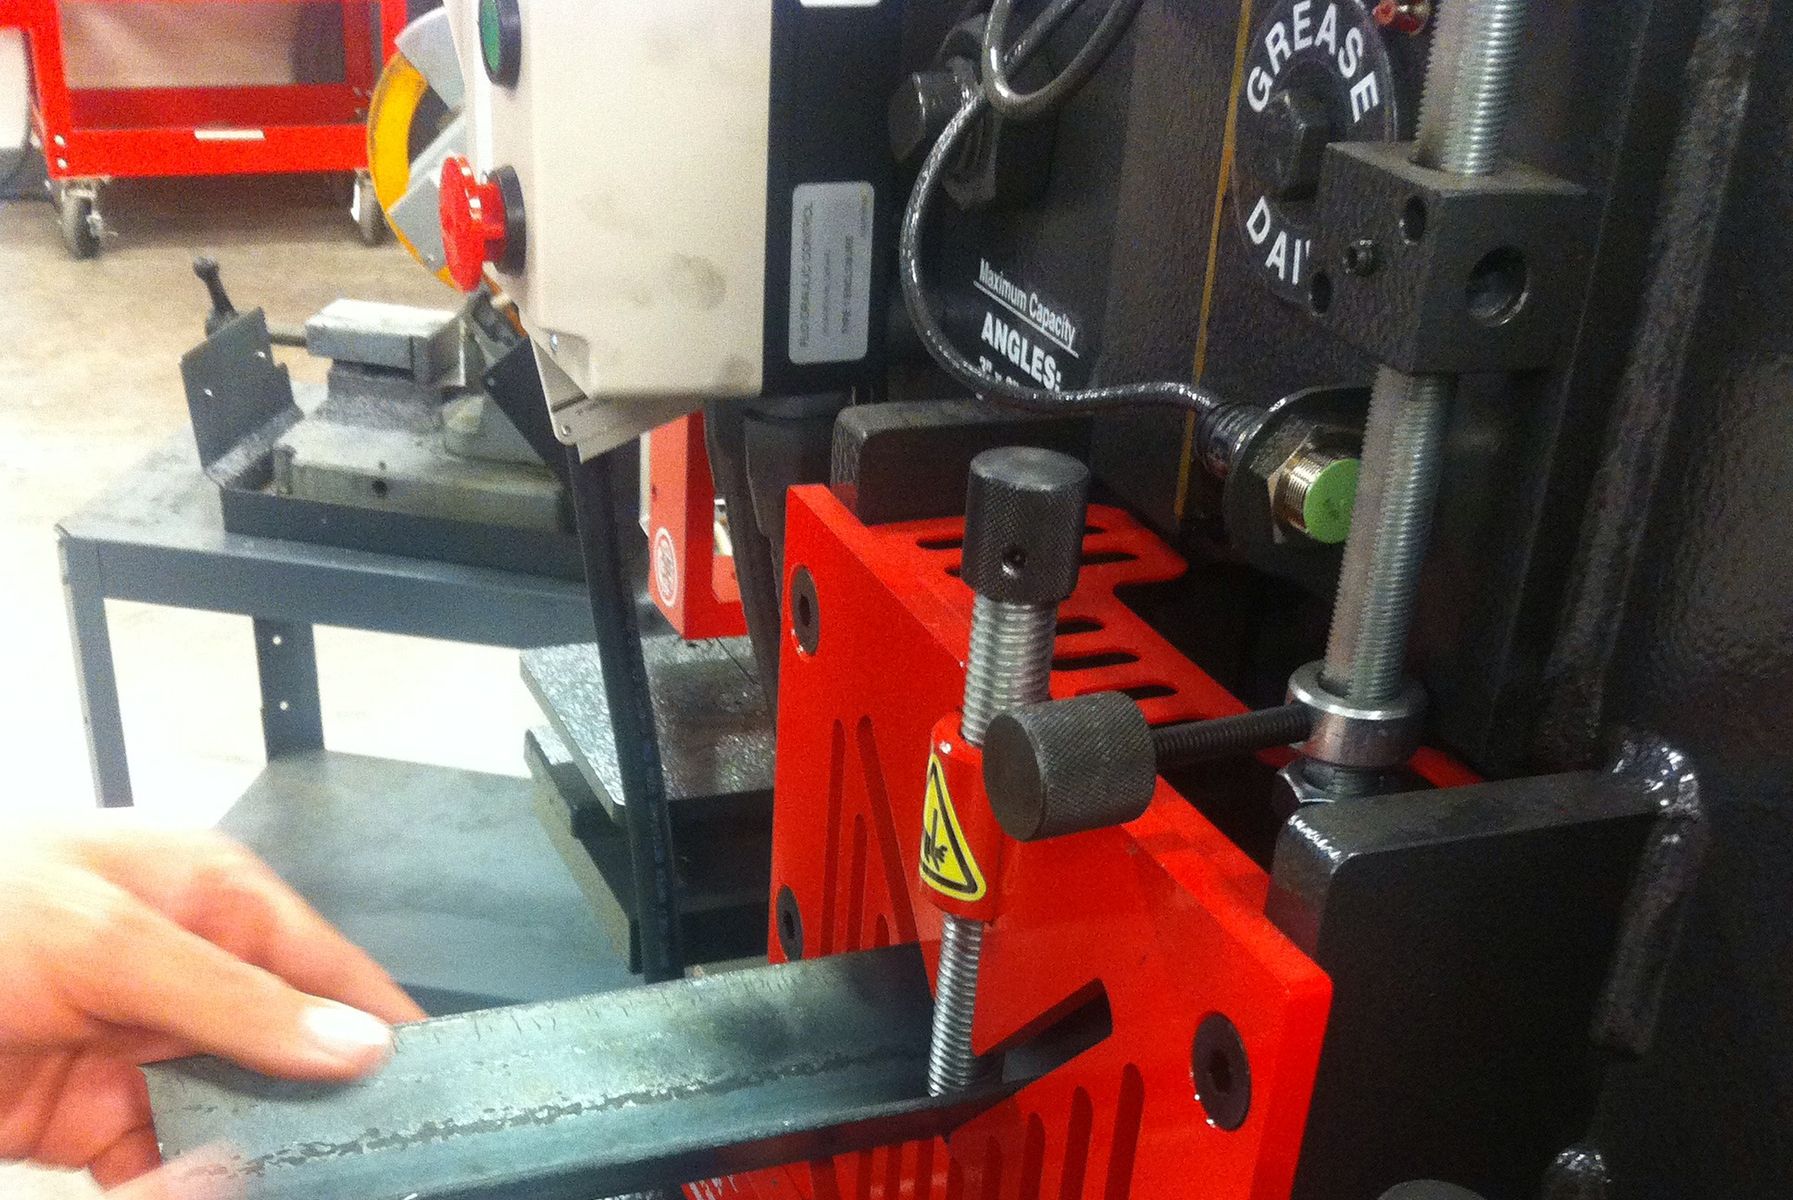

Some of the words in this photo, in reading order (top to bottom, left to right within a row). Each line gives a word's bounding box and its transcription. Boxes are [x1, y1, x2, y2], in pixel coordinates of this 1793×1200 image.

[1247, 0, 1380, 124] GREASE
[1246, 195, 1311, 286] DAI
[979, 257, 1027, 312] Maximum
[1029, 291, 1076, 349] Capacity
[980, 311, 1062, 393] ANGLES:
